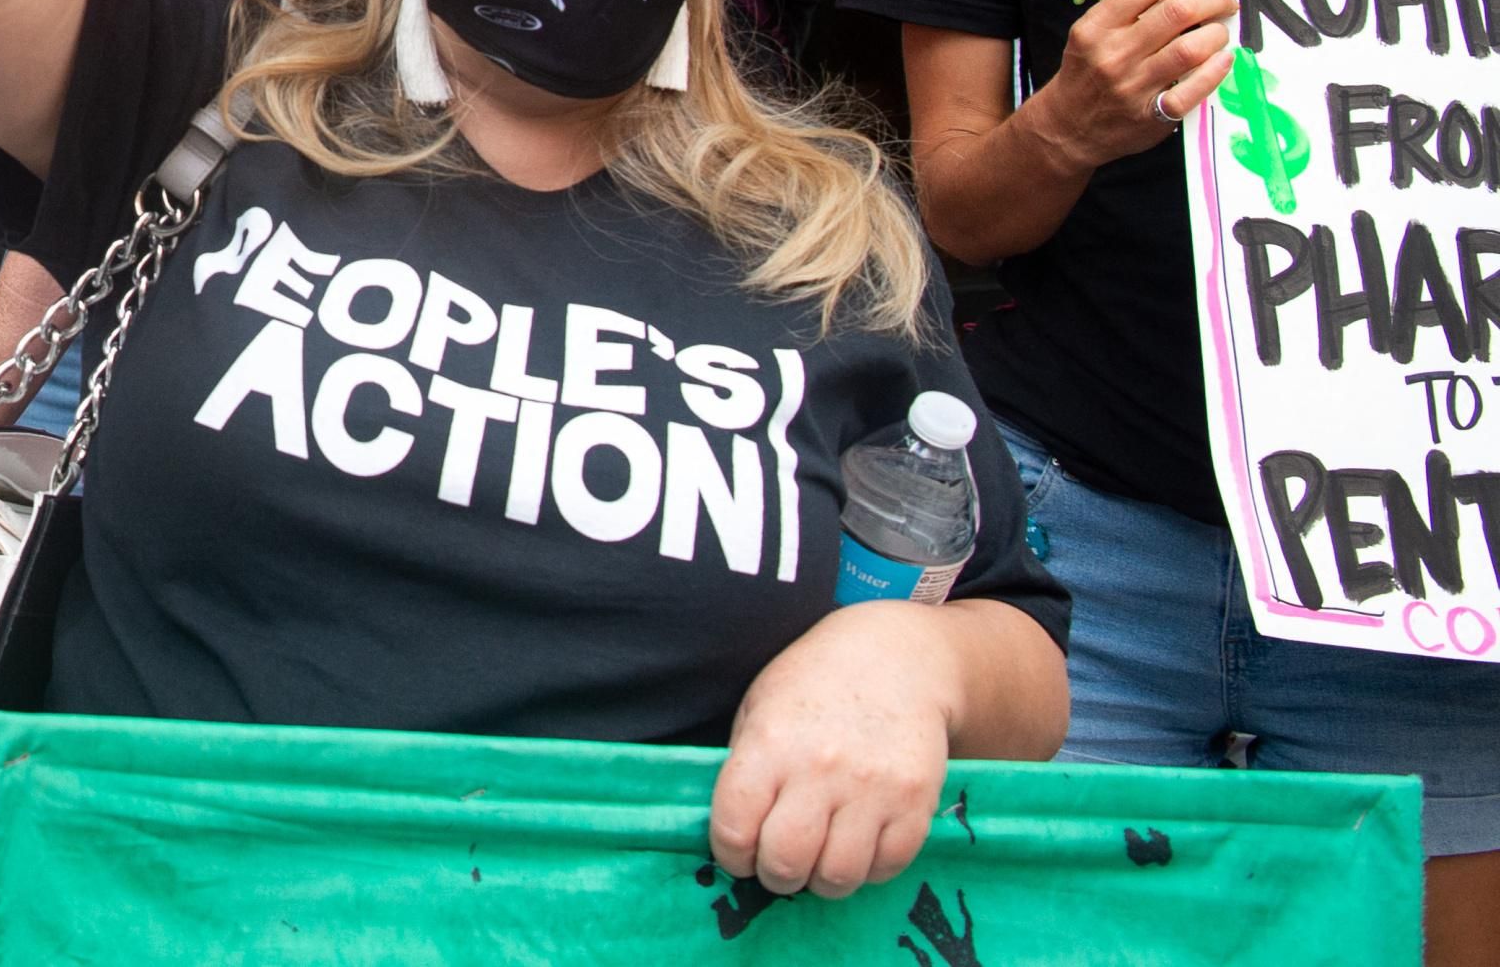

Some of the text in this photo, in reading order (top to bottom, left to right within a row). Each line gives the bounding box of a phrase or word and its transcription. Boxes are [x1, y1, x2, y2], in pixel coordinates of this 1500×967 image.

[194, 207, 765, 430] PEOPLE'S
[194, 320, 764, 575] ACTION
[1405, 371, 1484, 445] TO
[1403, 601, 1500, 656] CO
